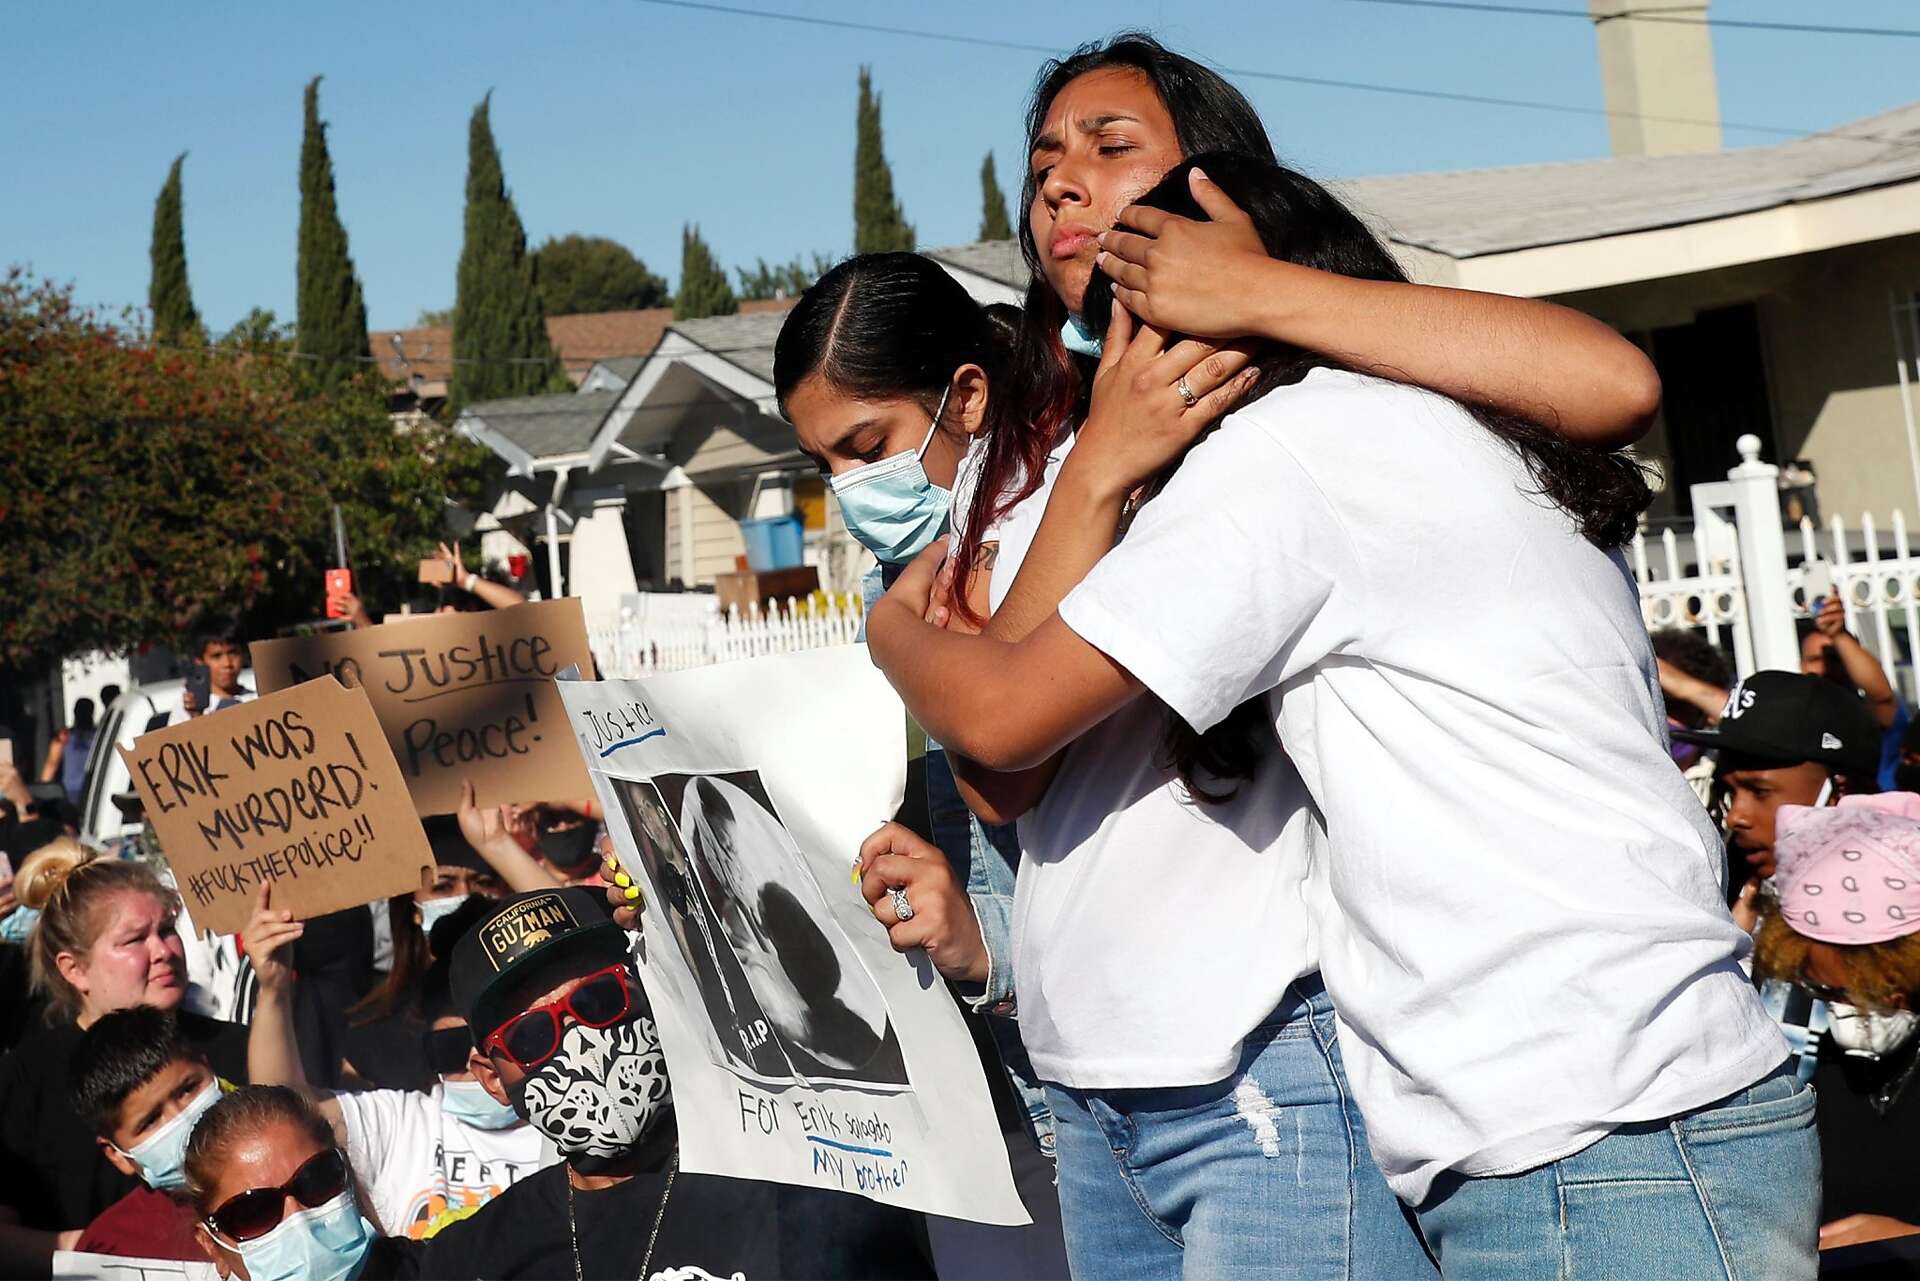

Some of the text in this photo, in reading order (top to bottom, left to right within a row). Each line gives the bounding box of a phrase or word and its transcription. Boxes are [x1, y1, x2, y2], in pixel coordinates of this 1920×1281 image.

[403, 693, 543, 777] Peace!
[137, 741, 229, 813] ERIK
[491, 905, 567, 954] GUZMAN
[495, 898, 548, 928] CALIFORNIA
[793, 1099, 841, 1137] Erik
